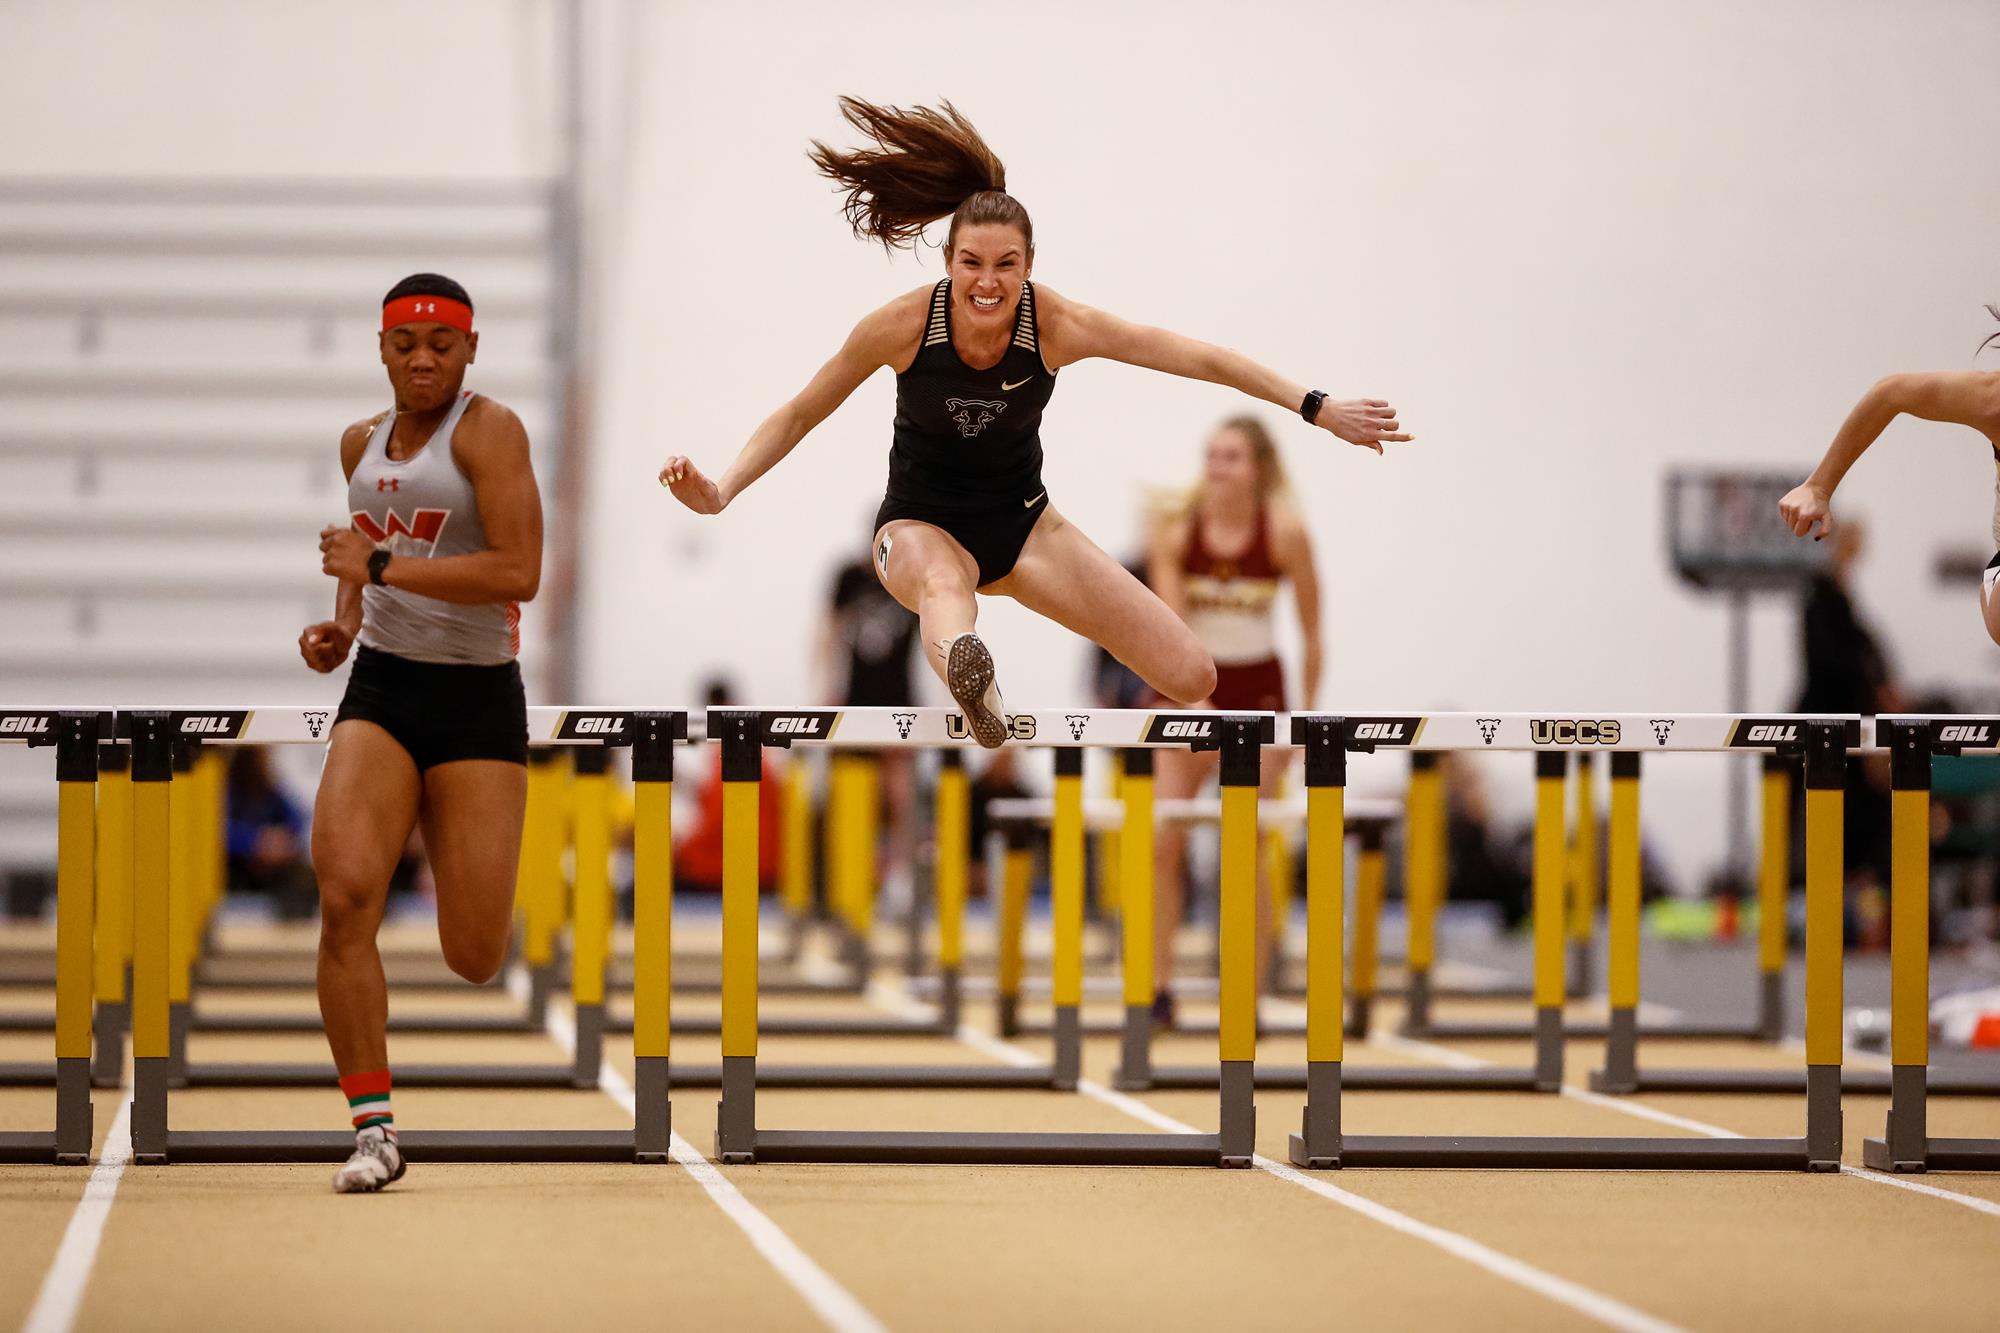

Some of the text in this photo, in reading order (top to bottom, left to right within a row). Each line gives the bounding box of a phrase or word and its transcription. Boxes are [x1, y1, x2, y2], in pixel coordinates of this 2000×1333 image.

[0, 716, 50, 733] GILL
[180, 716, 231, 733] GILL
[574, 717, 625, 734] GILL
[769, 717, 820, 734] GILL
[945, 714, 1037, 739] US
[1161, 720, 1212, 738] GILL
[1353, 723, 1405, 740] GILL
[1530, 719, 1621, 745] UCCS
[1747, 725, 1798, 742] GILL
[1939, 725, 1990, 742] GILL
